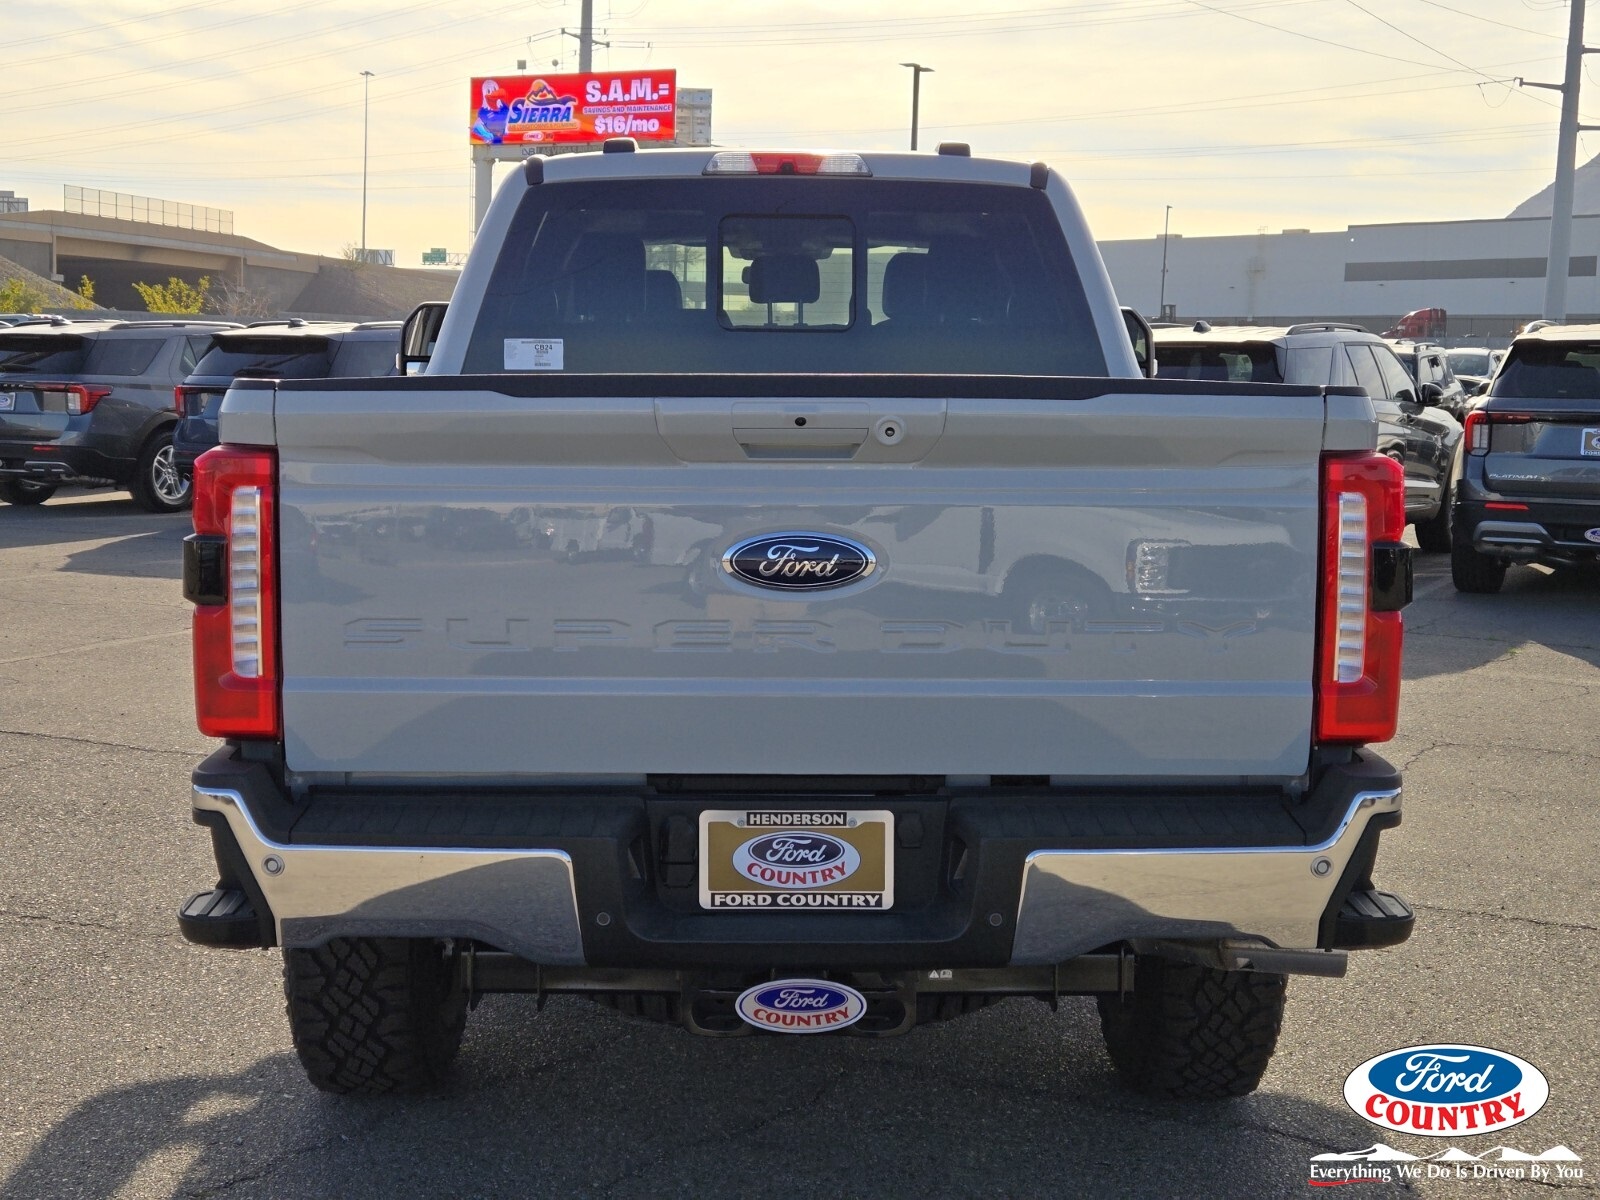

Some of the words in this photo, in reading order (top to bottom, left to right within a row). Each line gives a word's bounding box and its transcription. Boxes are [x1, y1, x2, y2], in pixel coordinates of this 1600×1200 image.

[508, 98, 571, 123] SIERRA
[627, 104, 671, 112] MAINTENANCE
[594, 115, 659, 134] $16/mo
[758, 544, 840, 577] Ford
[344, 617, 836, 653] SUPER
[749, 813, 844, 825] HENDERSON
[765, 837, 826, 862] Ford
[746, 861, 846, 885] COUNTRY
[714, 894, 773, 906] FORD
[776, 894, 880, 906] COUNTRY
[774, 988, 829, 1008] Ford
[753, 1006, 850, 1027] COUNTRY
